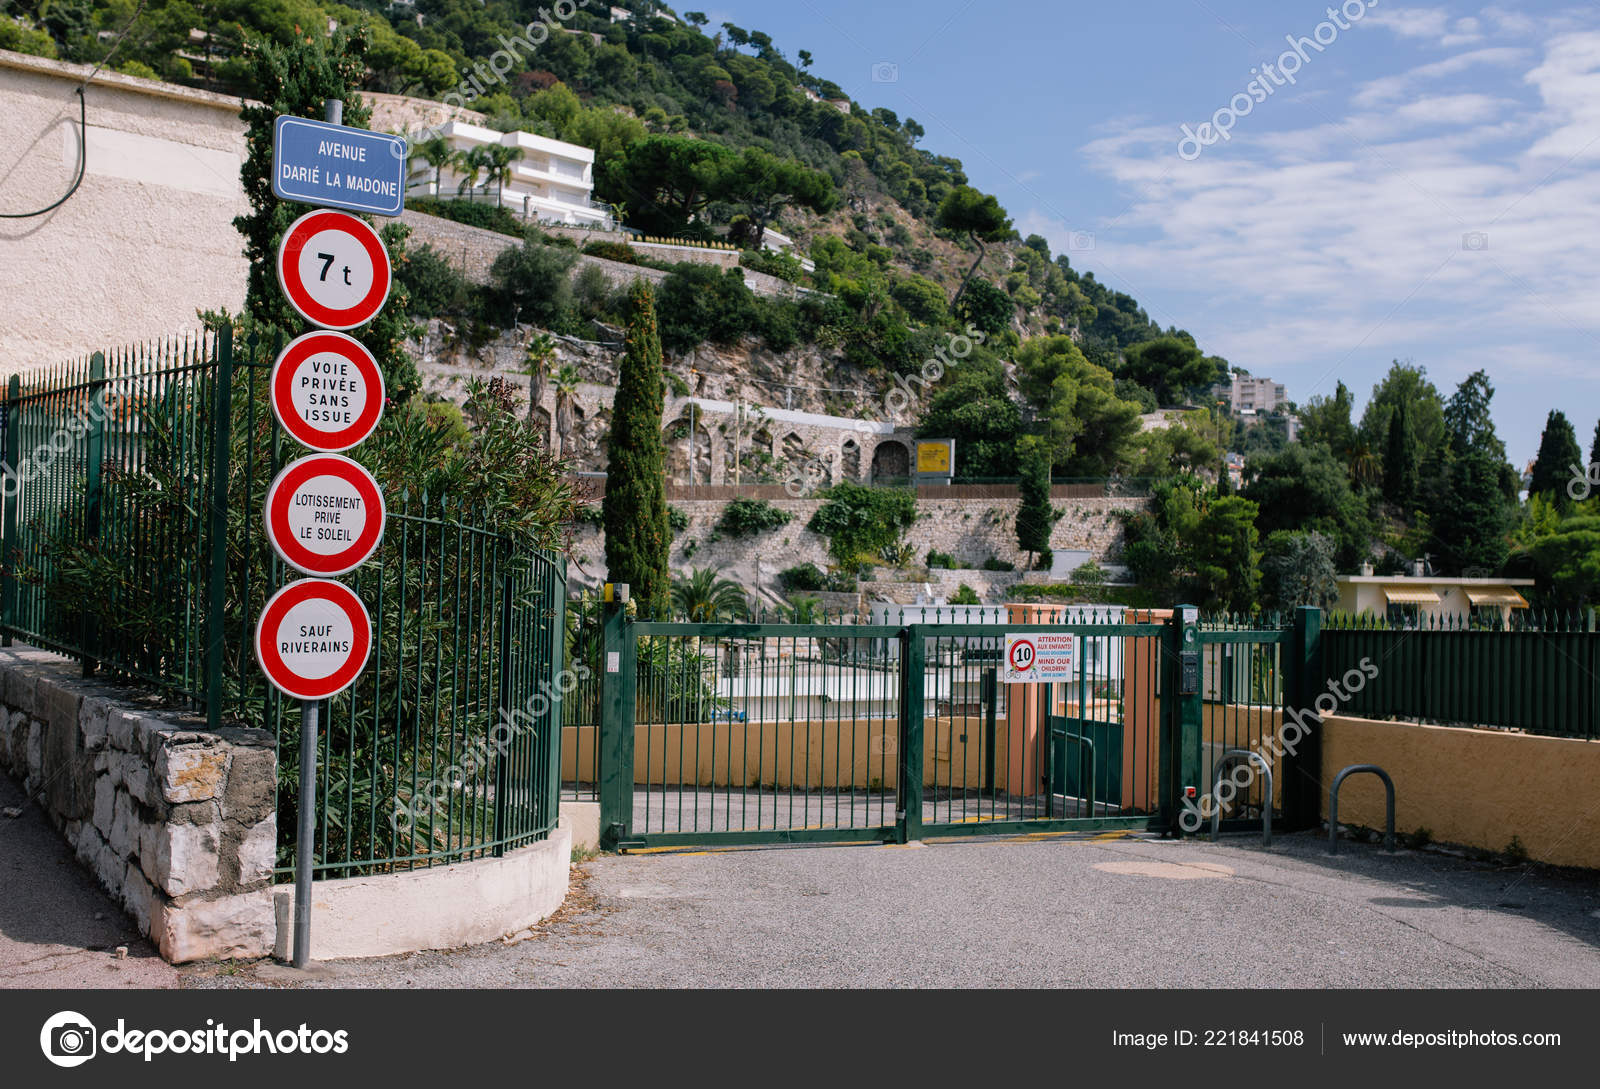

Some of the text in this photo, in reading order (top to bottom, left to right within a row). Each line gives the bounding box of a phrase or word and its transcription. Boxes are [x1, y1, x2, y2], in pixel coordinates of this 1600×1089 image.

[318, 140, 367, 162] AVENUE
[282, 164, 397, 197] DARIÉ LA MADONE
[317, 252, 352, 286] 7 t
[312, 361, 348, 376] VOIE
[301, 376, 357, 392] PRIVÉE
[309, 393, 349, 408] SANS
[305, 409, 351, 424] ISSUE
[295, 493, 361, 510] LOTISSEMENT
[300, 526, 352, 542] LE SOLEIL
[299, 625, 333, 638] SAUF
[281, 640, 349, 654] RIVERAINS
[1016, 648, 1031, 662] 10
